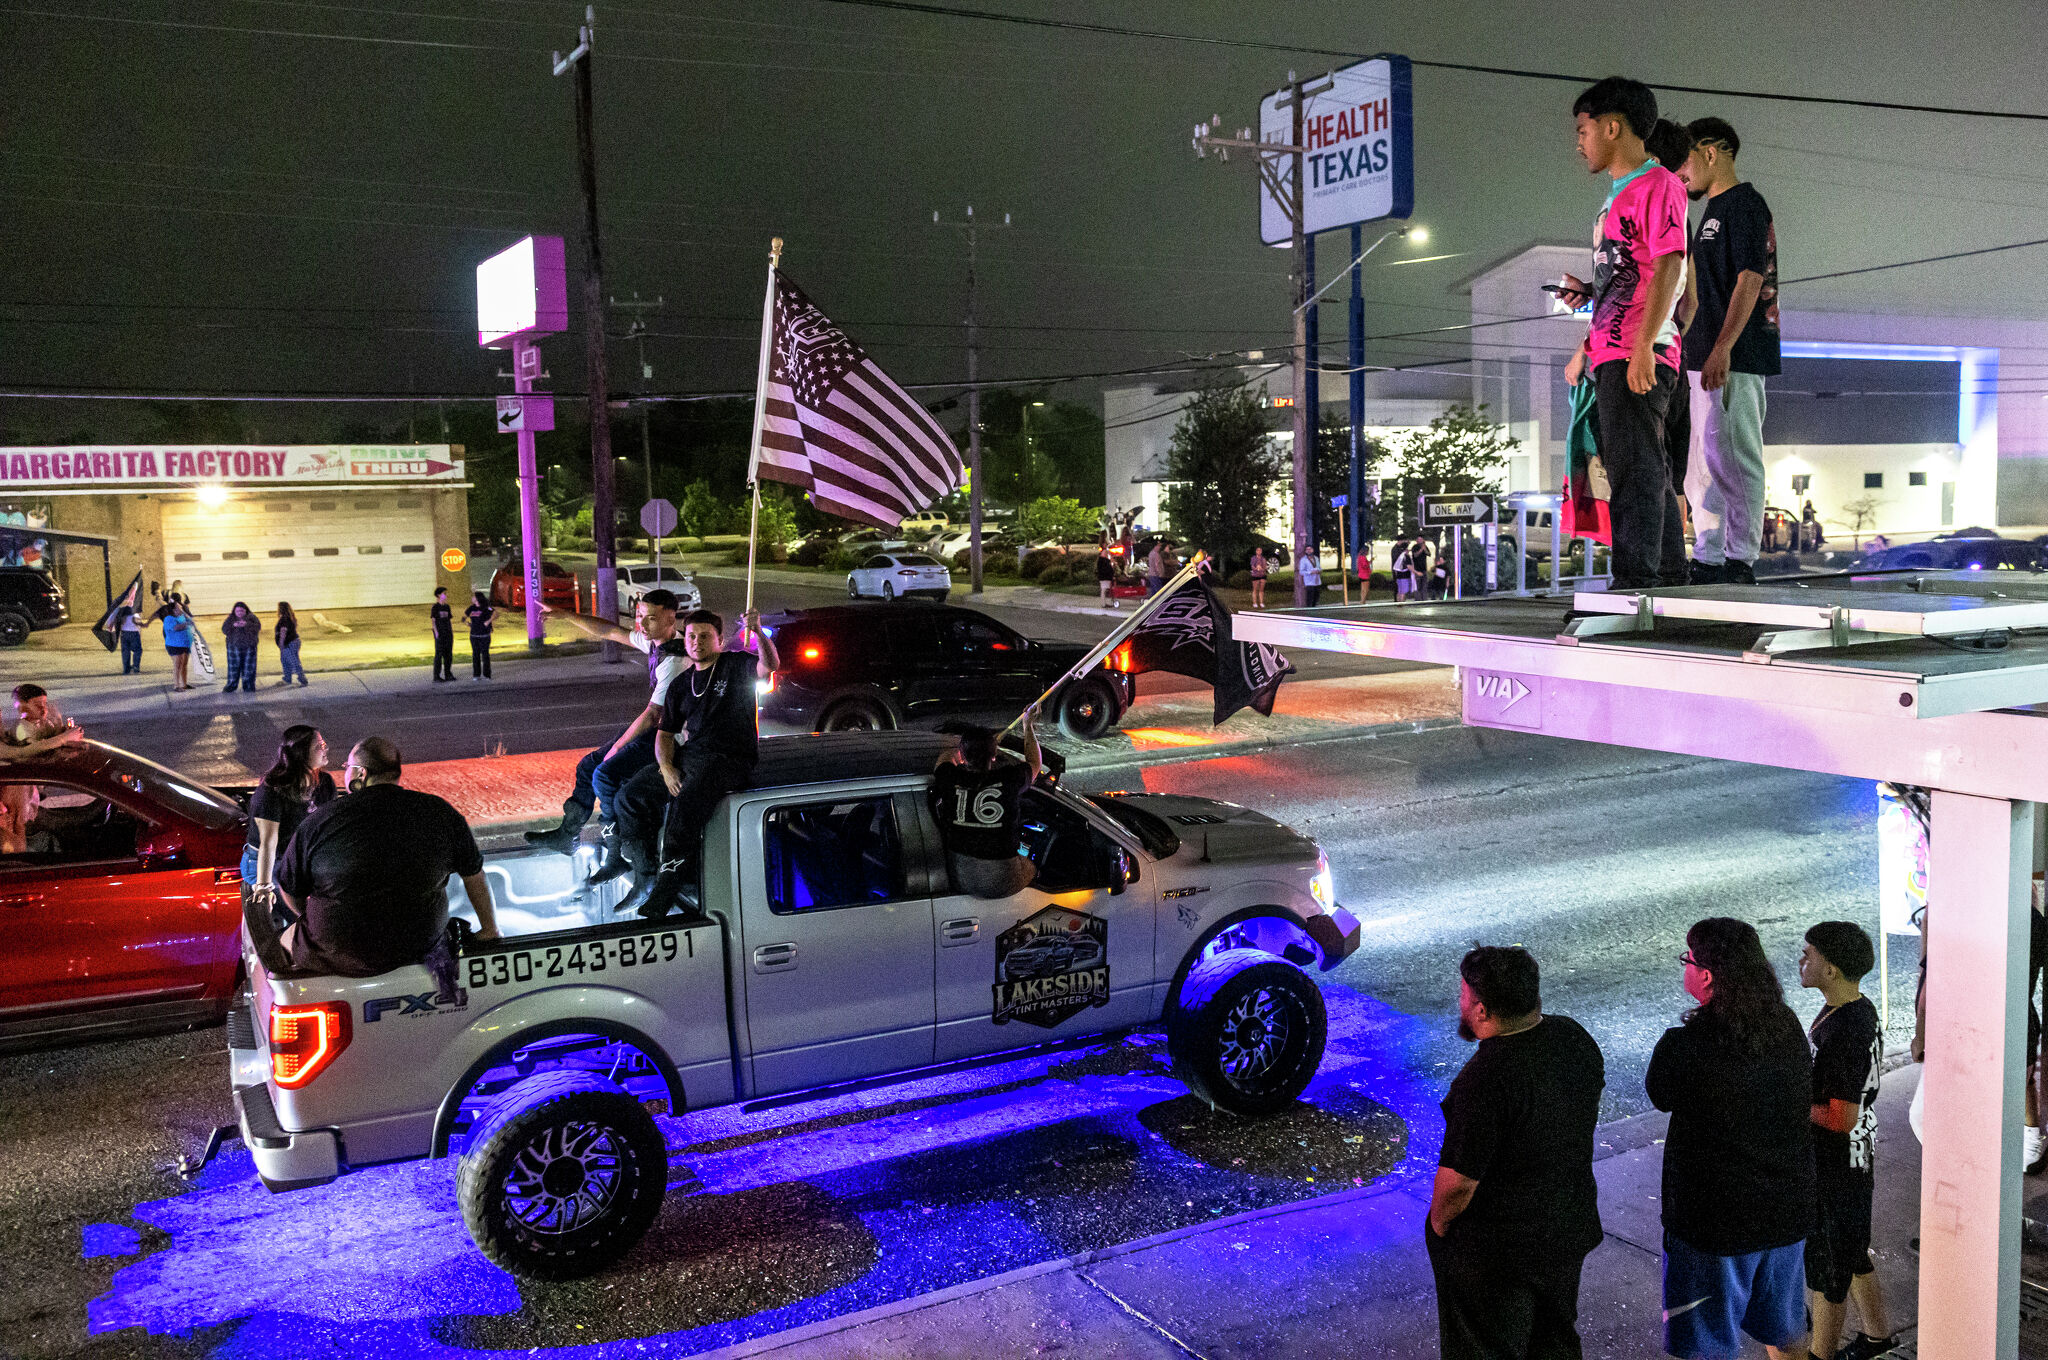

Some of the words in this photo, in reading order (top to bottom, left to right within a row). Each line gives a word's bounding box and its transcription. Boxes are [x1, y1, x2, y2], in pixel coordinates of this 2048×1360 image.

[1307, 98, 1388, 150] HEALTH
[1308, 138, 1389, 188] TEXAS
[1312, 184, 1340, 198] PRIMARY
[1341, 180, 1357, 192] CARE
[1358, 173, 1389, 189] DOCTORS
[165, 450, 288, 478] FACTORY
[353, 462, 428, 474] THRU
[1434, 504, 1453, 516] ONE
[1455, 504, 1473, 515] WAY
[443, 555, 464, 565] STOP
[530, 559, 539, 597] 1738
[1476, 674, 1514, 699] VIA
[955, 787, 1005, 824] 16
[468, 930, 694, 989] 830-243-8291
[996, 967, 1107, 1018] LAKESIDE
[1014, 1002, 1039, 1015] TINT
[1040, 995, 1088, 1009] MASTERS
[410, 1011, 432, 1019] OFF
